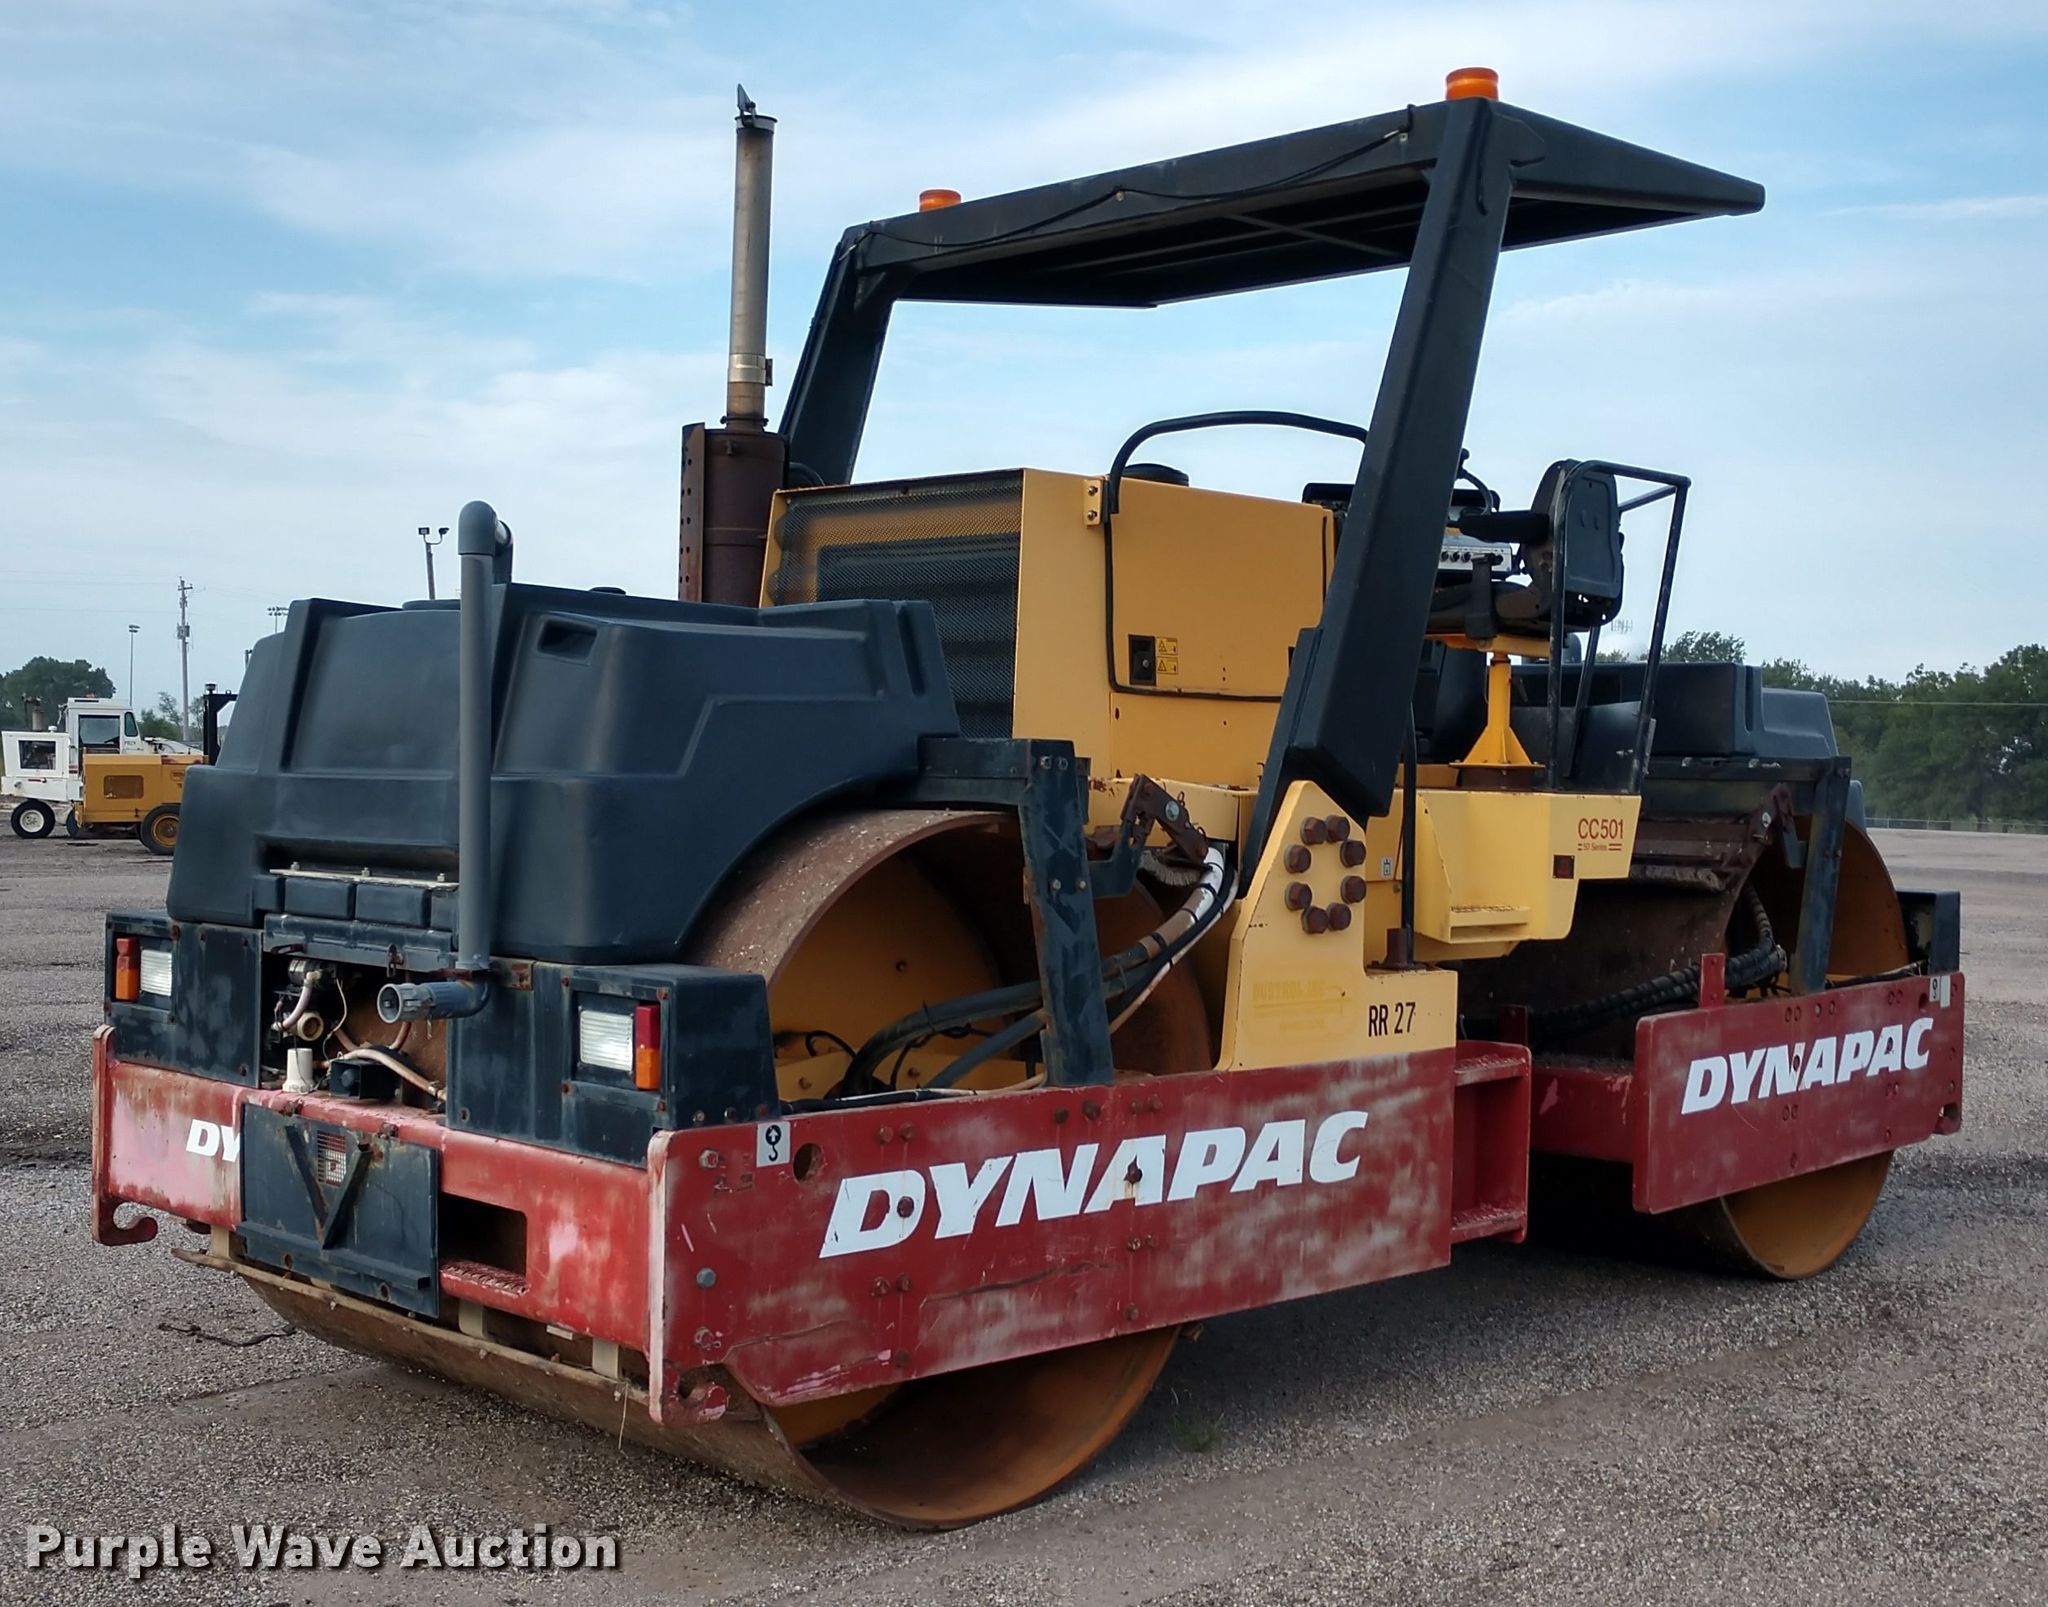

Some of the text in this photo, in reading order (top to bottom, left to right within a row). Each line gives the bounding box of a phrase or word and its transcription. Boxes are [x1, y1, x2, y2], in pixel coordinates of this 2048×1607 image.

[1578, 818, 1623, 839] CC501
[1369, 1005, 1388, 1037] RR
[1394, 1002, 1416, 1034] 27
[1681, 1018, 1934, 1114] DYNAPAC
[819, 1111, 1368, 1258] DYNAPAC
